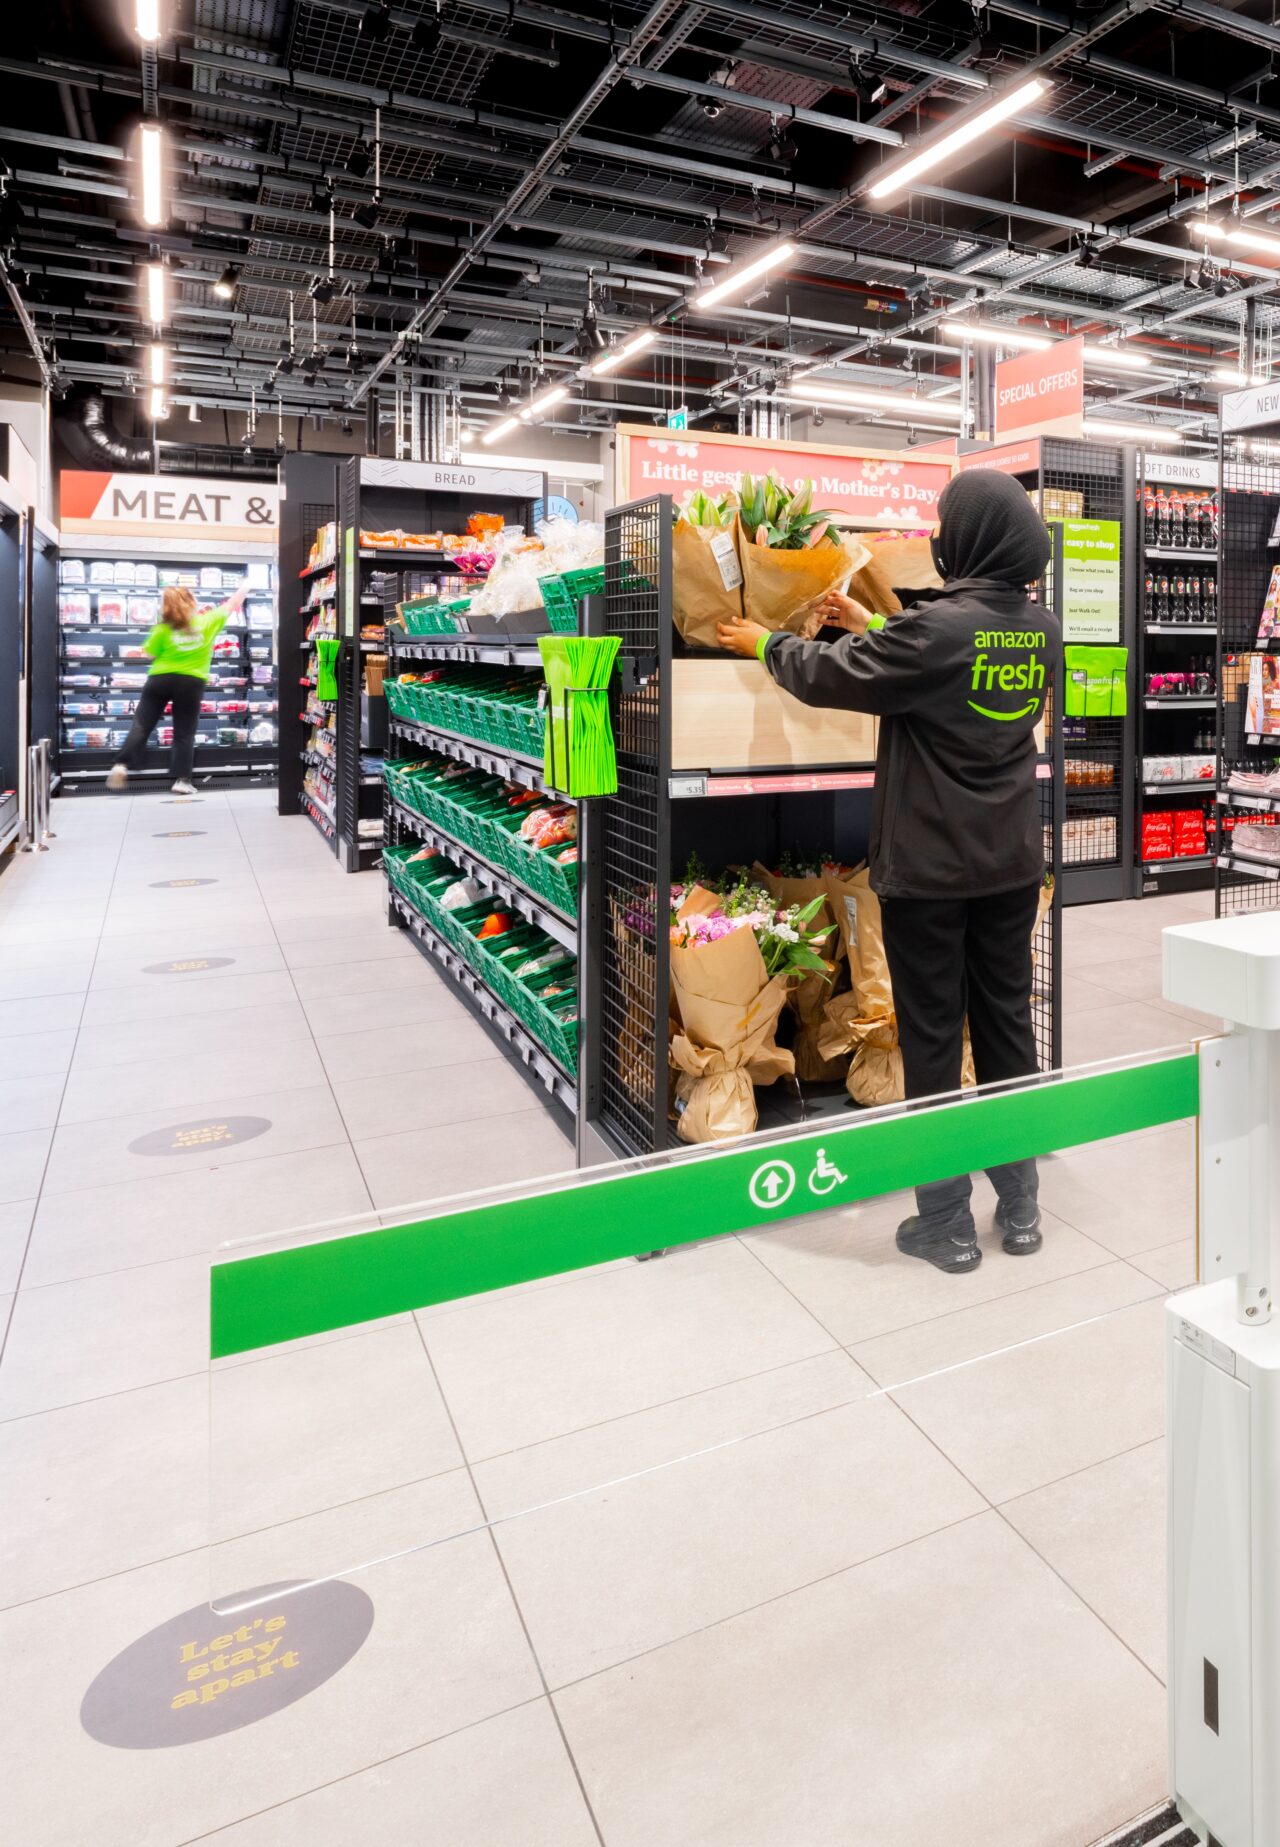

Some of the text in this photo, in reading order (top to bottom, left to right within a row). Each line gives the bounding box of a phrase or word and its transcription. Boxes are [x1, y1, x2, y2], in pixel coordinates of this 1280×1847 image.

[999, 368, 1078, 407] SPECIAL OFFERS
[435, 472, 476, 486] BREAD
[641, 460, 699, 481] Little
[820, 477, 900, 499] Mother's
[903, 484, 940, 504] Day.
[1143, 462, 1201, 478] OFT DRINKS
[112, 489, 275, 525] MEAT &
[1066, 540, 1115, 551] easy to shop
[974, 630, 1046, 648] amazon
[971, 653, 1046, 691] fresh
[180, 1615, 287, 1664] Let's
[187, 1637, 283, 1682] stay
[170, 1650, 300, 1710] apart
